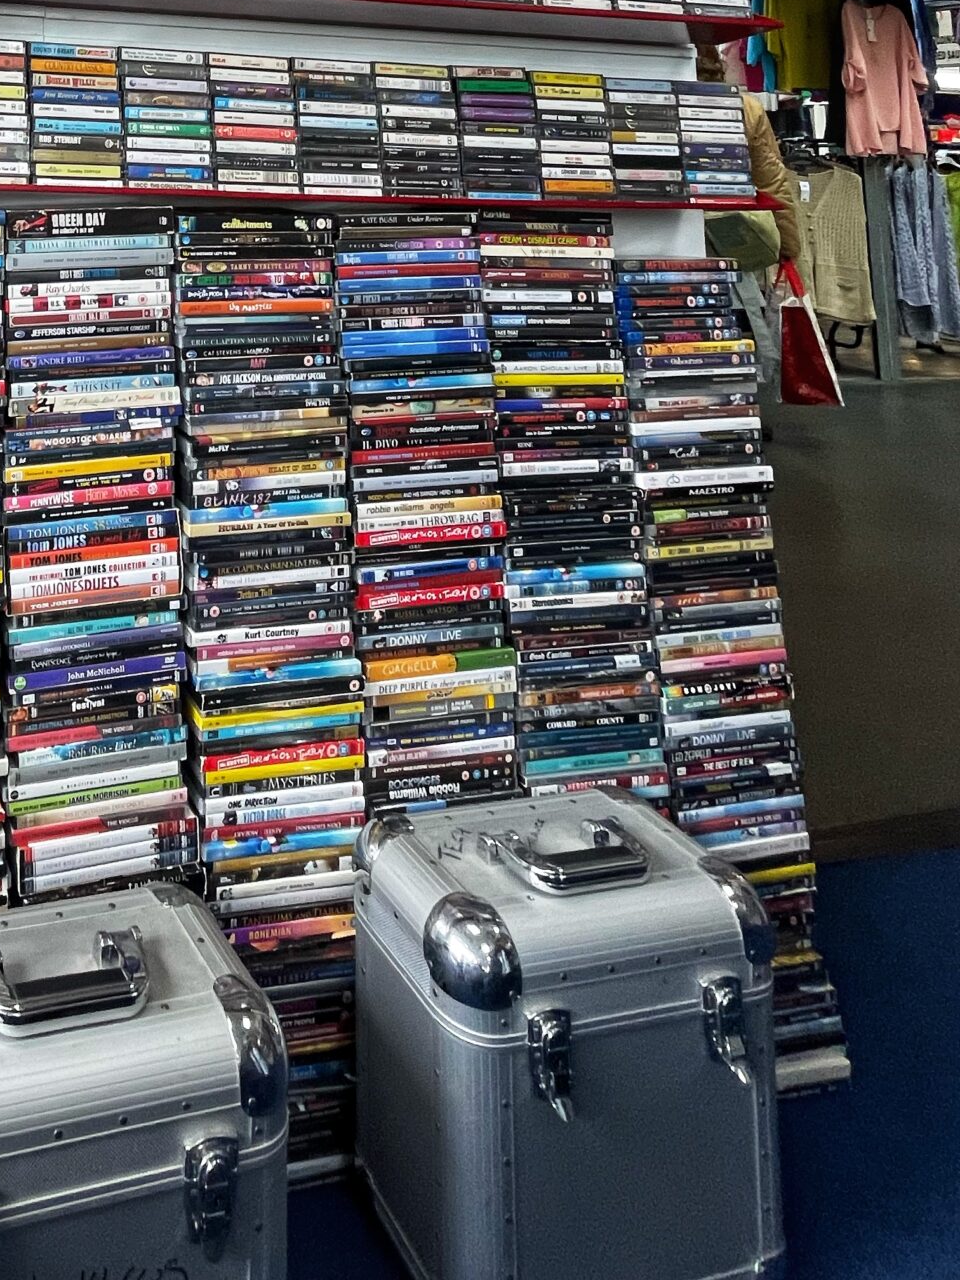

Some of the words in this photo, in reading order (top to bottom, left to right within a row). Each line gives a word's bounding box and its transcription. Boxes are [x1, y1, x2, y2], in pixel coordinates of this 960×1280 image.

[51, 214, 83, 227] GREEN
[85, 212, 106, 226] DAY
[218, 375, 230, 384] JOE
[232, 374, 261, 383] JACKSON
[43, 434, 98, 447] WOODSTOCK
[100, 431, 132, 441] DIARIES
[689, 486, 735, 496] MAESTRO
[30, 492, 74, 507] PENNYWISE
[203, 492, 250, 507] BLINK
[252, 492, 272, 504] 182
[366, 505, 391, 514] robbie
[393, 502, 424, 512] williams
[430, 501, 455, 511] angels
[531, 598, 574, 608] Stereophonics
[244, 630, 261, 639] Kurt
[265, 628, 300, 639] Courtney
[67, 671, 84, 681] John
[86, 665, 125, 679] McNicholl
[382, 660, 439, 675] COACHELLA
[379, 683, 397, 694] DEEP
[399, 681, 429, 692] PURPLE
[268, 772, 336, 790] MYSTERIES
[68, 794, 91, 805] JAMES
[92, 789, 129, 802] MORRISON
